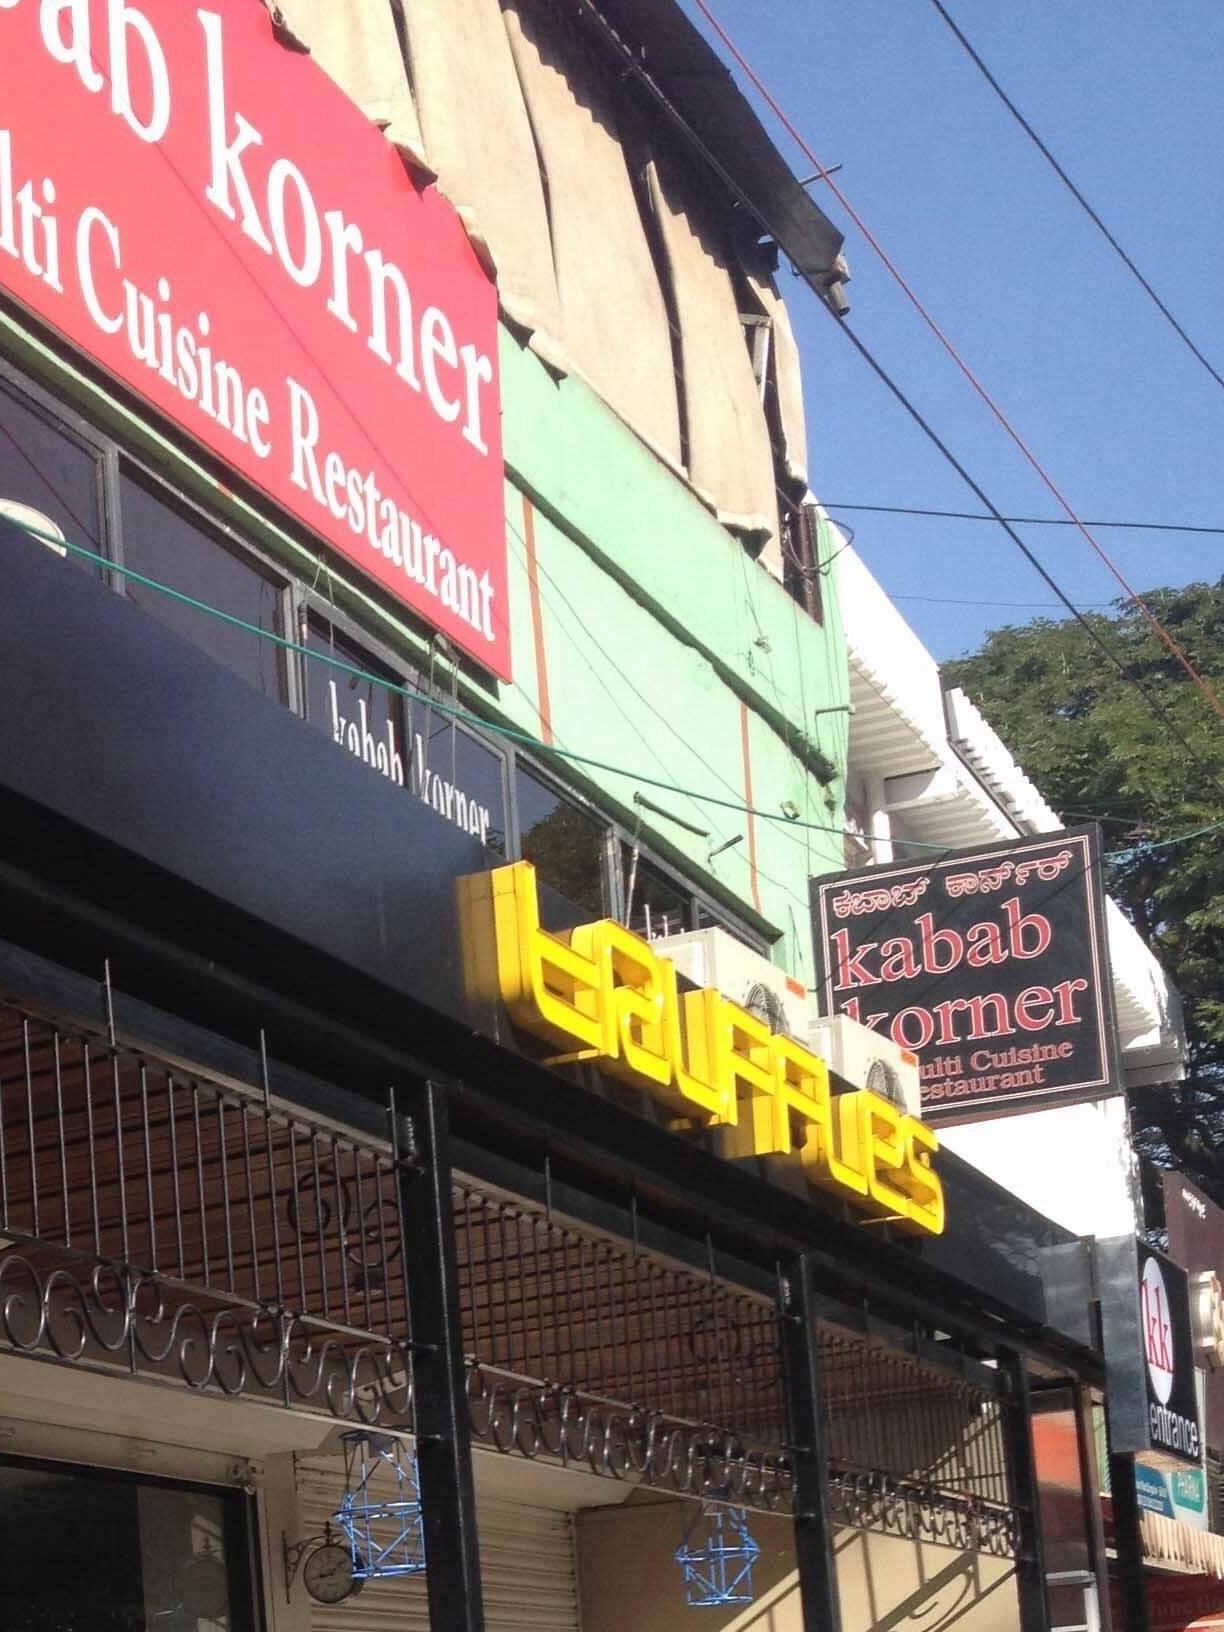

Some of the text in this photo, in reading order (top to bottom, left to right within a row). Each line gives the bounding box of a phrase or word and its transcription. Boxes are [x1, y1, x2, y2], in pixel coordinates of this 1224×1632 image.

[196, 8, 493, 456] korner
[77, 207, 272, 459] Cuisine
[285, 377, 495, 642] Restaurant
[831, 897, 1053, 992] kabab
[919, 1041, 1074, 1080] ulti Cuisine
[919, 1064, 1046, 1101] estaurant
[1150, 1402, 1199, 1458] entrance
